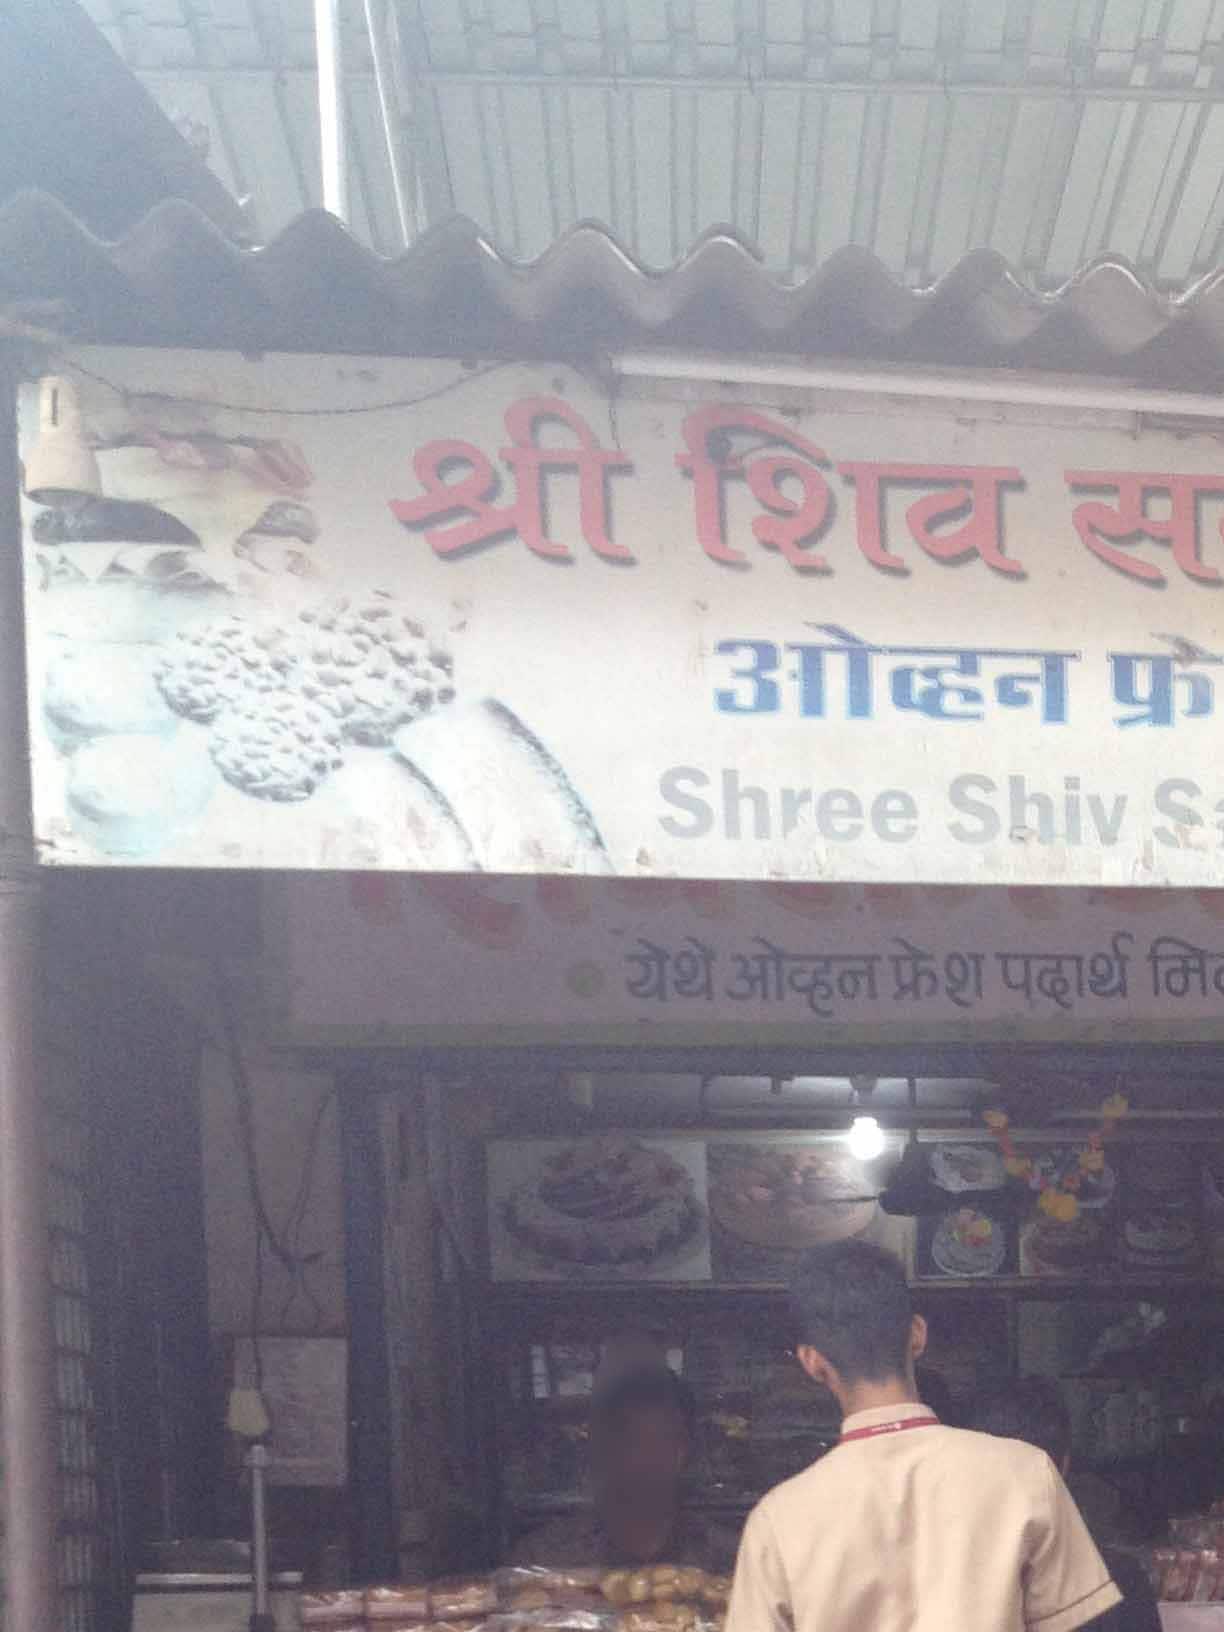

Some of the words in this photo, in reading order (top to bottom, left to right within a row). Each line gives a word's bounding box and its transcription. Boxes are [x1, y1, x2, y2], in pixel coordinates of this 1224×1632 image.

[387, 398, 636, 564] श्री
[675, 404, 1027, 580] शिव
[712, 621, 1082, 727] ओव्हन
[657, 764, 919, 845] Shree
[947, 772, 1129, 850] Shiv
[625, 936, 716, 1002] येथे
[727, 934, 883, 1018] ओव्हन
[889, 936, 984, 1008] फ्रेश
[996, 932, 1132, 1011] पदार्थ
